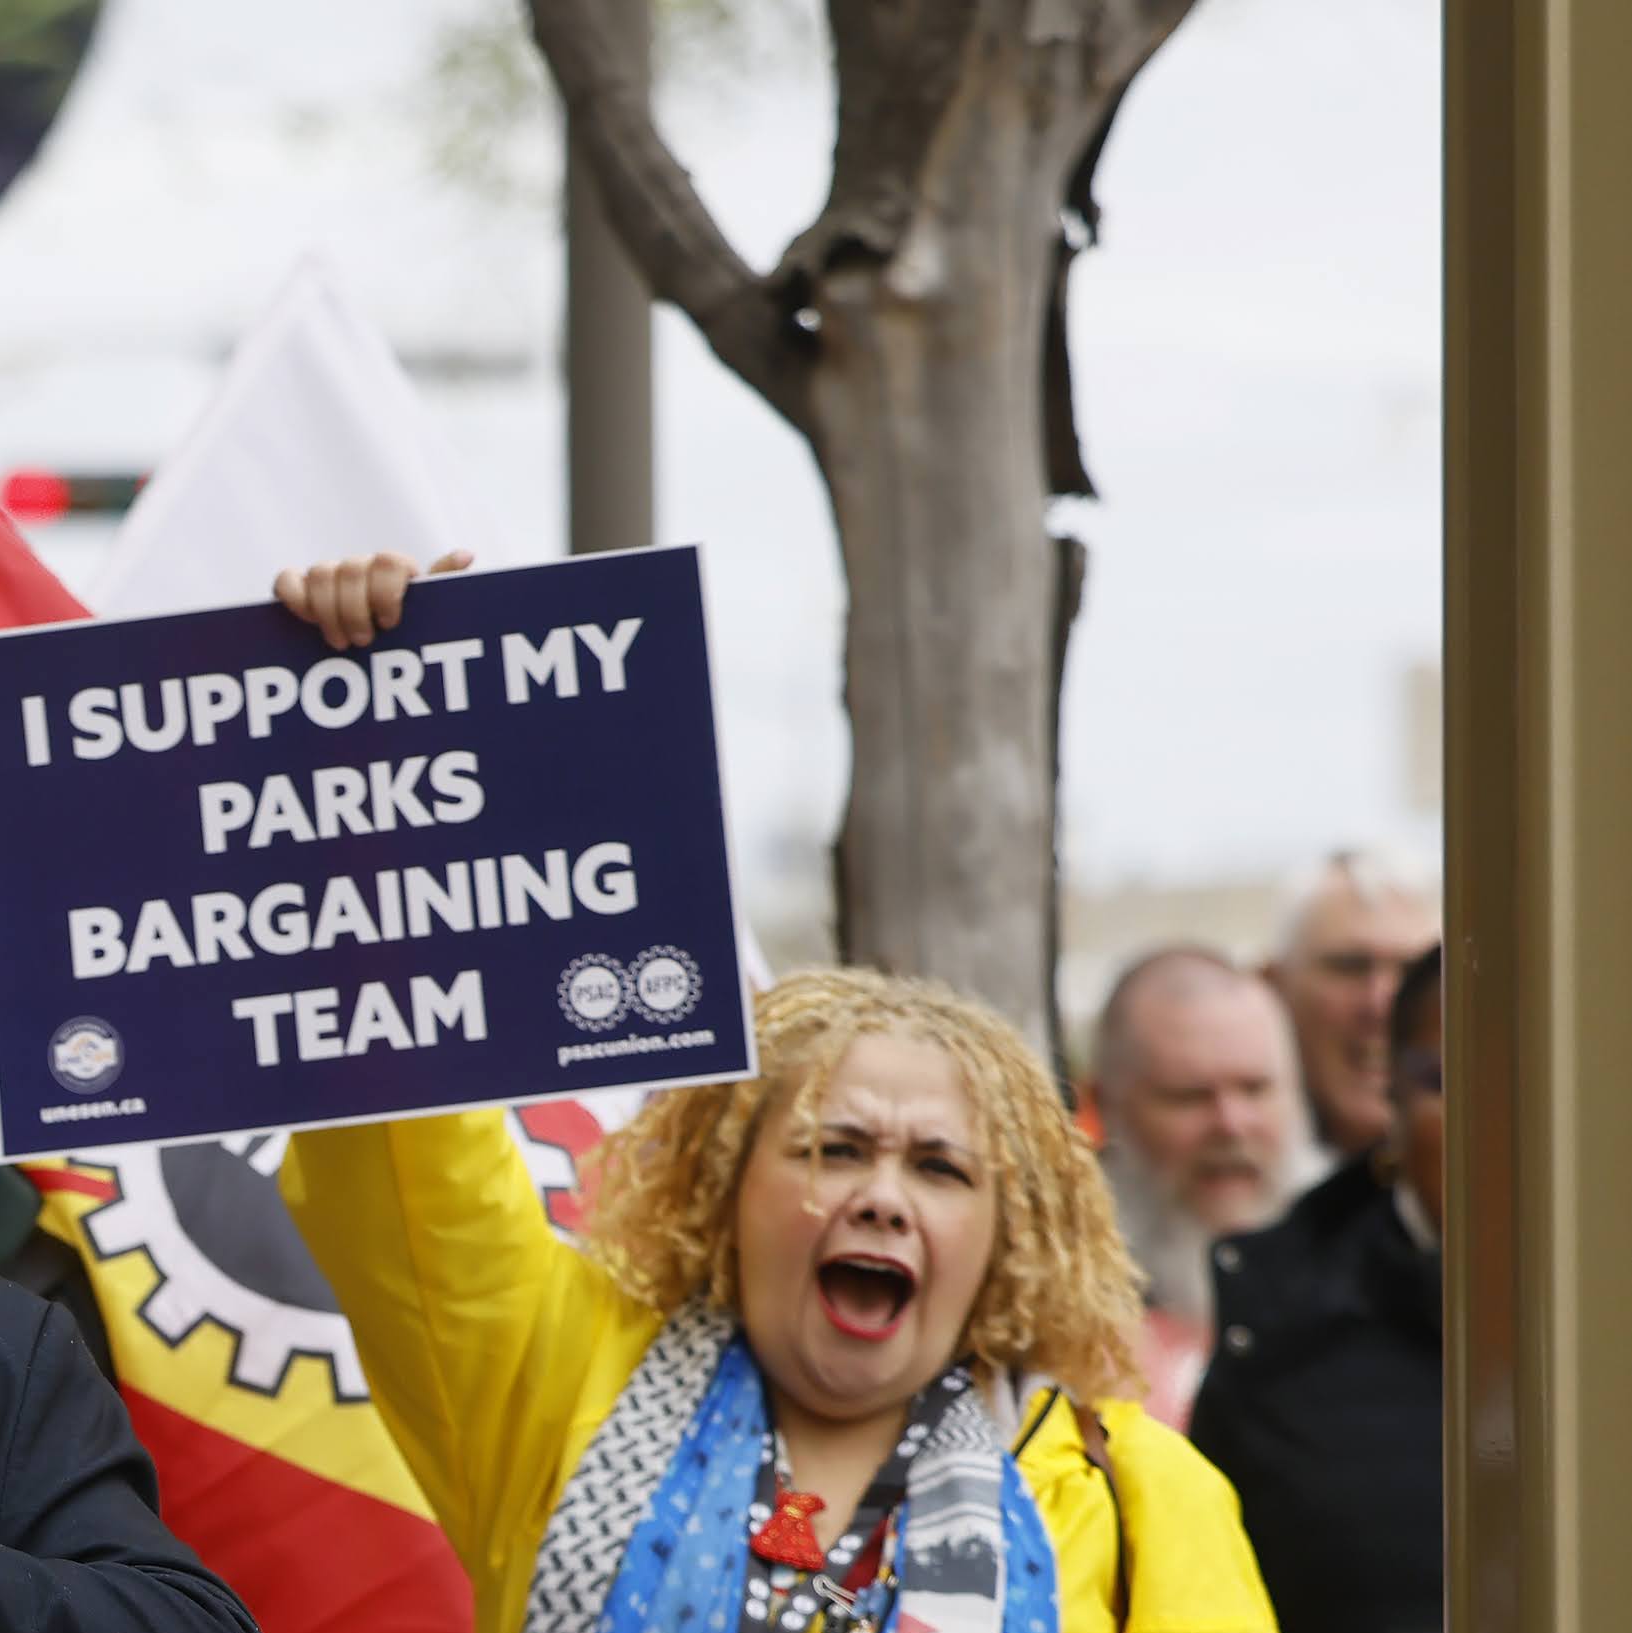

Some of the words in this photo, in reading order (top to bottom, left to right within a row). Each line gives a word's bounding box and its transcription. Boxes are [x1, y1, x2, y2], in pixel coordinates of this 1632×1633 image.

[21, 695, 53, 767] I
[67, 637, 485, 761] SUPPORT
[500, 616, 644, 706] MY
[198, 750, 486, 854] PARKS
[67, 841, 639, 980] BARGAINING
[232, 969, 488, 1067] TEAM
[557, 1029, 716, 1068] psacunion.com
